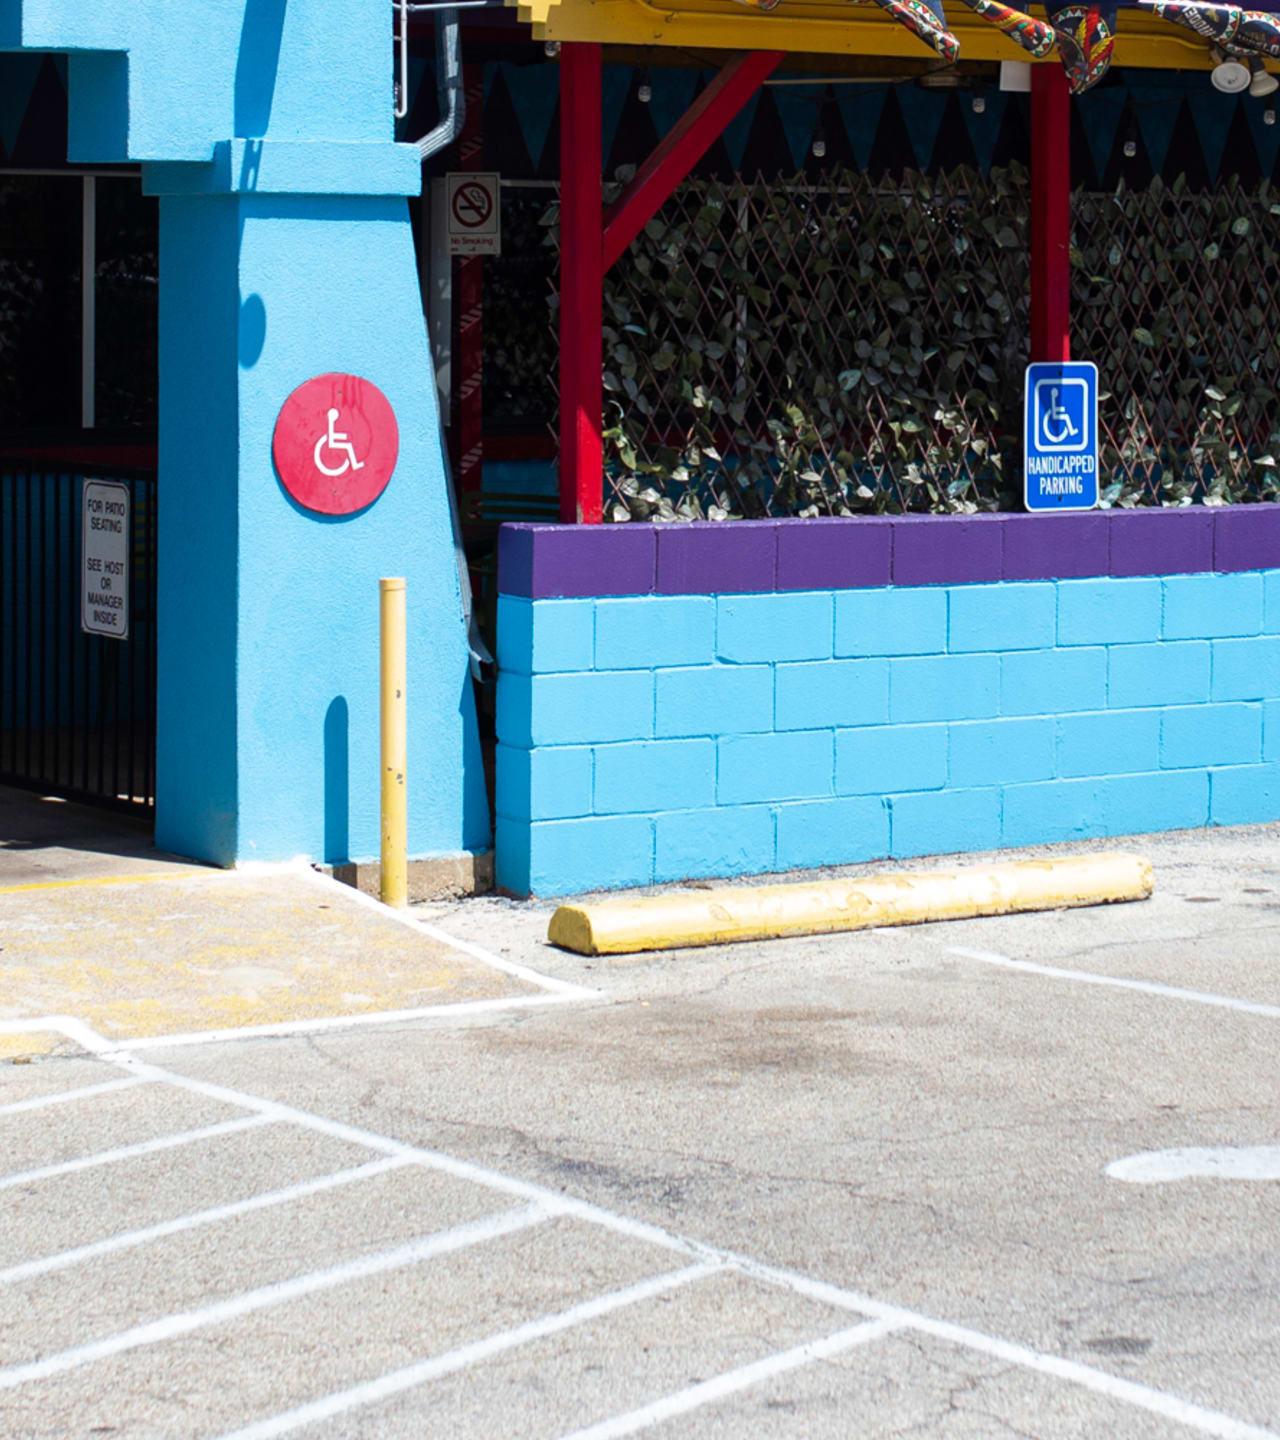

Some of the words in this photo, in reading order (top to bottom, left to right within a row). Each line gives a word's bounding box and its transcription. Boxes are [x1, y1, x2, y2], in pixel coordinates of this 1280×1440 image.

[1028, 455, 1094, 475] HANDICAPPED
[1040, 477, 1083, 495] PARKING
[87, 498, 104, 513] FOR
[105, 501, 125, 517] PATIO
[91, 517, 122, 533] SEATING
[87, 558, 102, 572] SEE
[105, 560, 124, 576] HOST
[100, 577, 112, 591] OR
[87, 591, 124, 610] MANAGER
[93, 610, 118, 627] INSIDE
